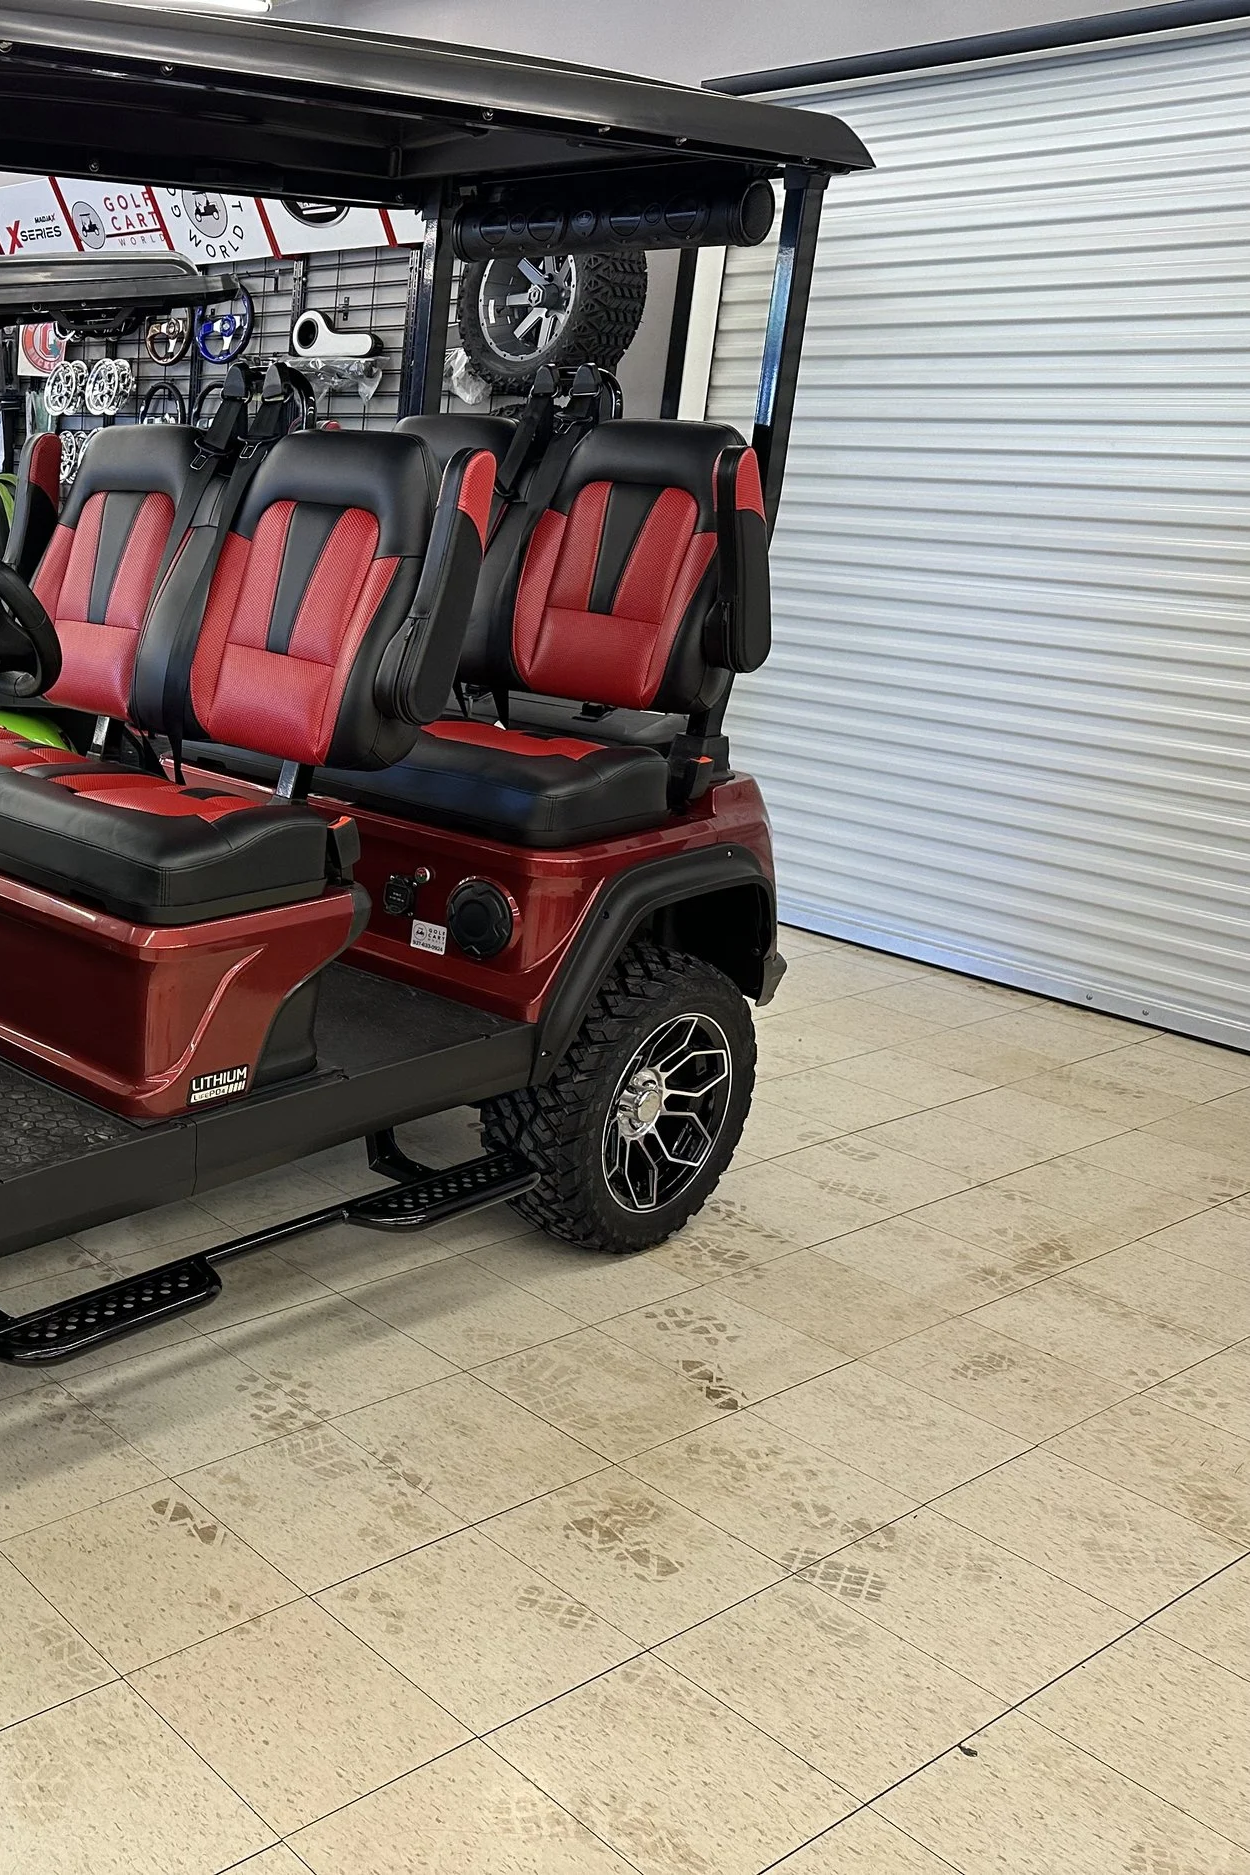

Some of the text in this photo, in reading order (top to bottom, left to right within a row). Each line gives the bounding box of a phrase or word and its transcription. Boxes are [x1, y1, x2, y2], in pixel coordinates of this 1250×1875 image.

[103, 191, 151, 212] GOLF
[111, 211, 158, 231] CART
[118, 233, 165, 247] WORLD
[189, 225, 244, 258] WORLD
[192, 1066, 248, 1092] LITHIUM
